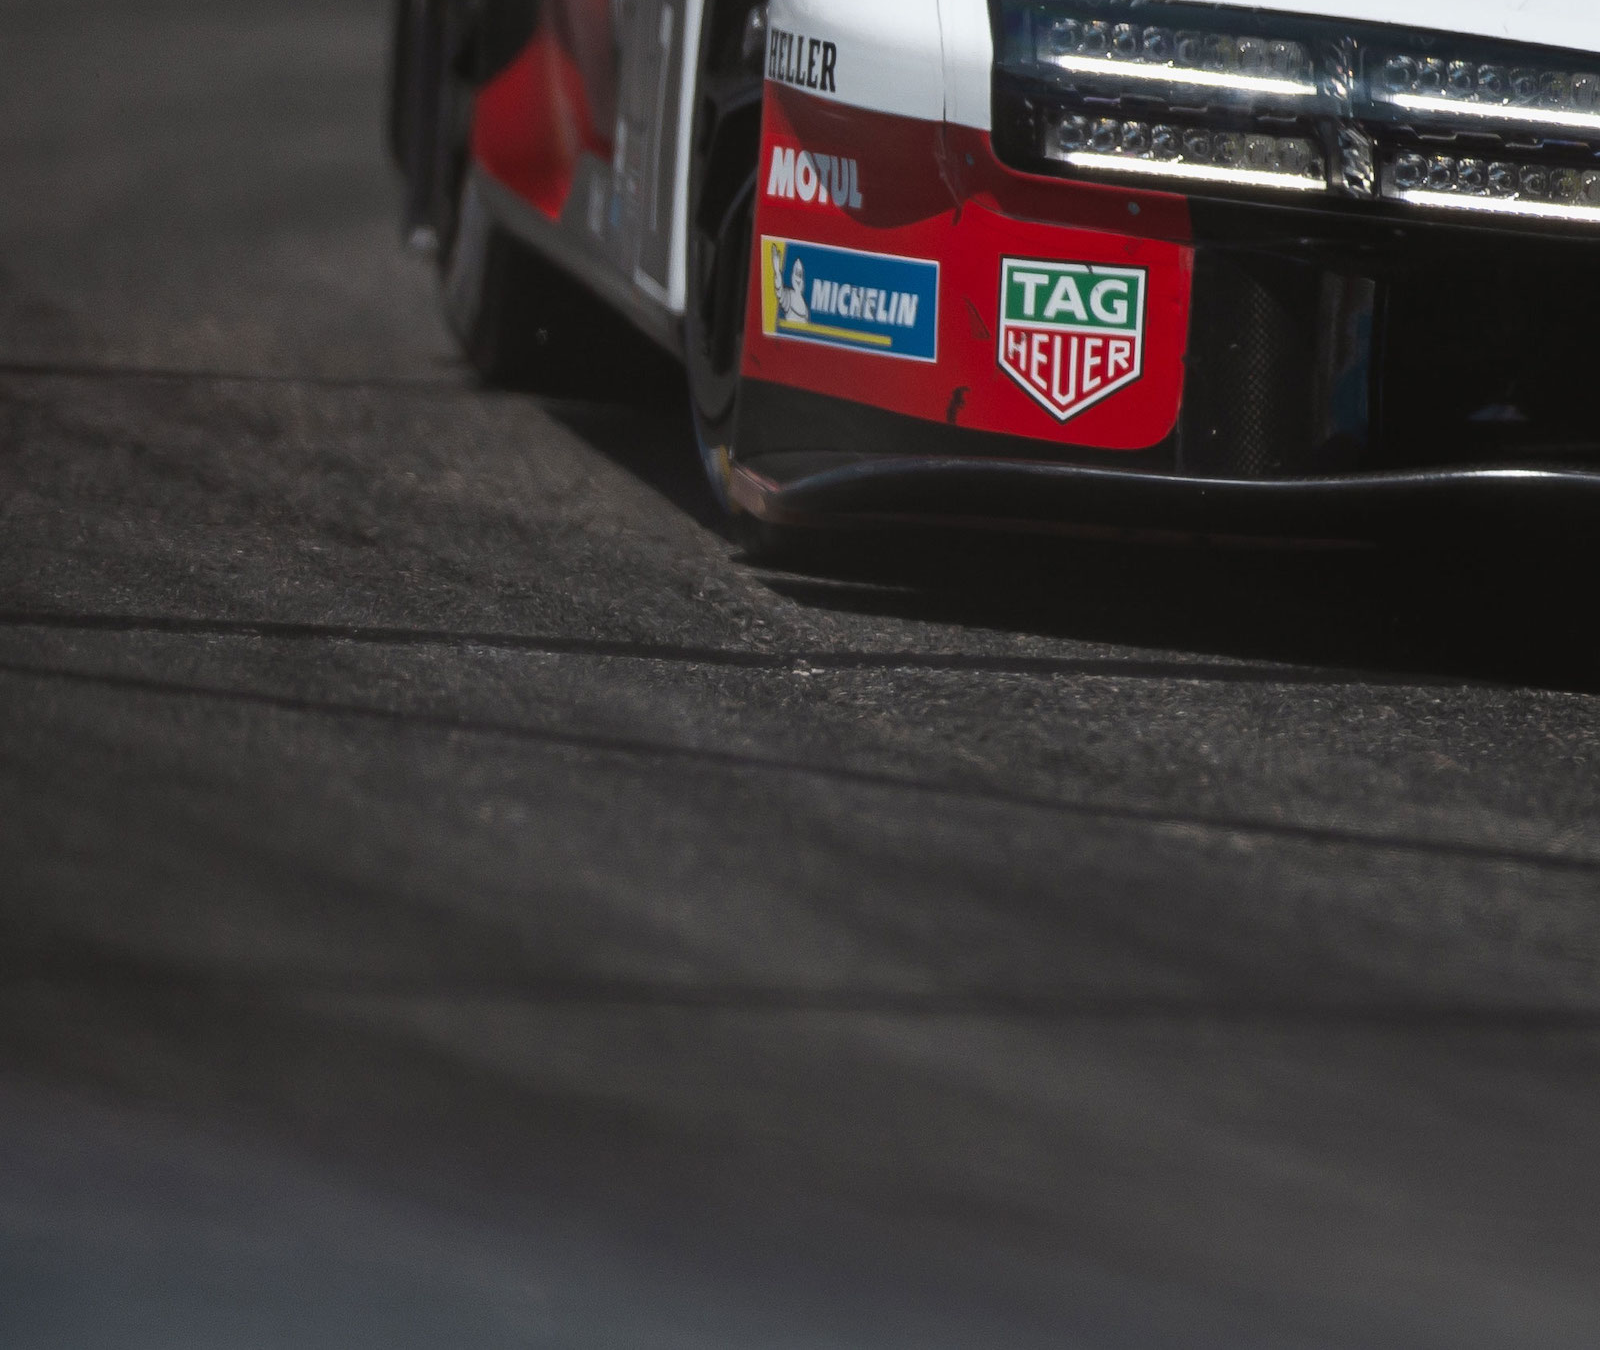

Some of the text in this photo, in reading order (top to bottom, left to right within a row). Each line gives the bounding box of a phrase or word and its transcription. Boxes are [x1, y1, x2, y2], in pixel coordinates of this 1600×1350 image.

[768, 28, 837, 93] HELLER
[766, 145, 864, 210] MOTUL
[810, 277, 920, 329] MICHELIN
[1012, 271, 1129, 325] TAG
[1007, 330, 1132, 406] HEUER
